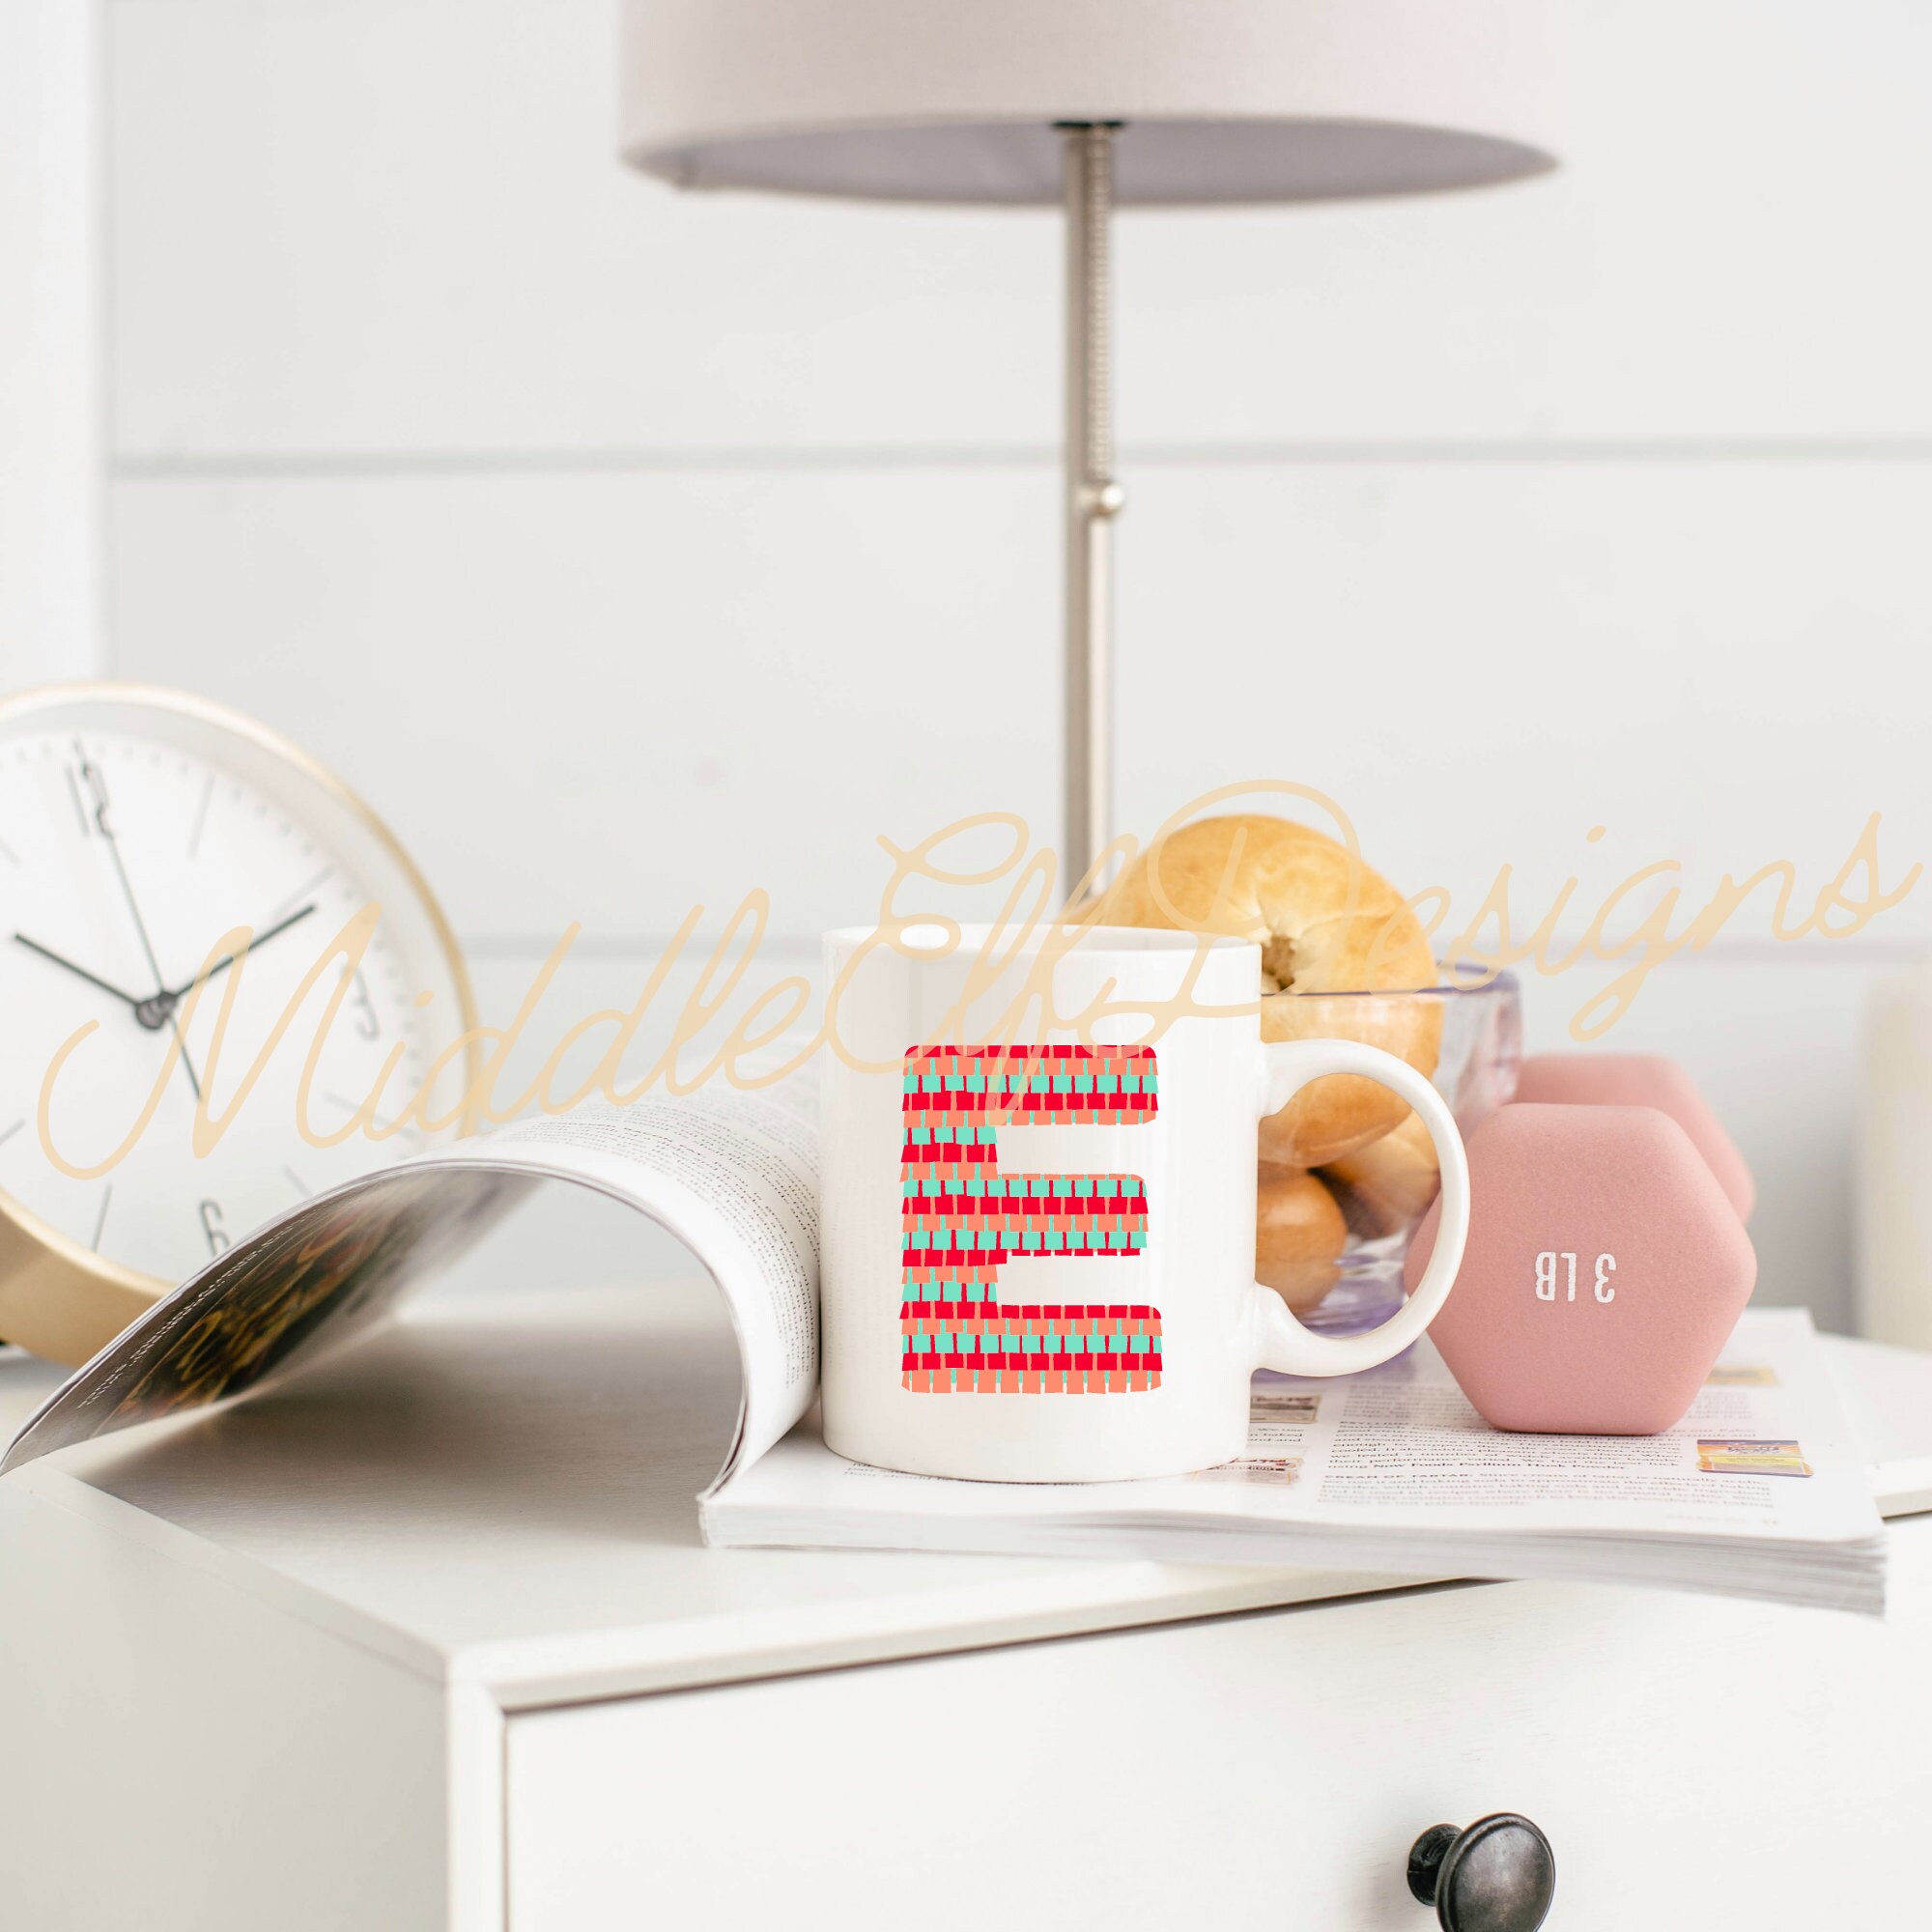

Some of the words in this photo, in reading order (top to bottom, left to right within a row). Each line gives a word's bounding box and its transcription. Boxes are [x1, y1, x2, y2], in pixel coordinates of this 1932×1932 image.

[341, 964, 380, 1040] 3
[899, 1044, 1163, 1395] E
[1534, 1251, 1577, 1302] LB
[1594, 1253, 1617, 1303] 3
